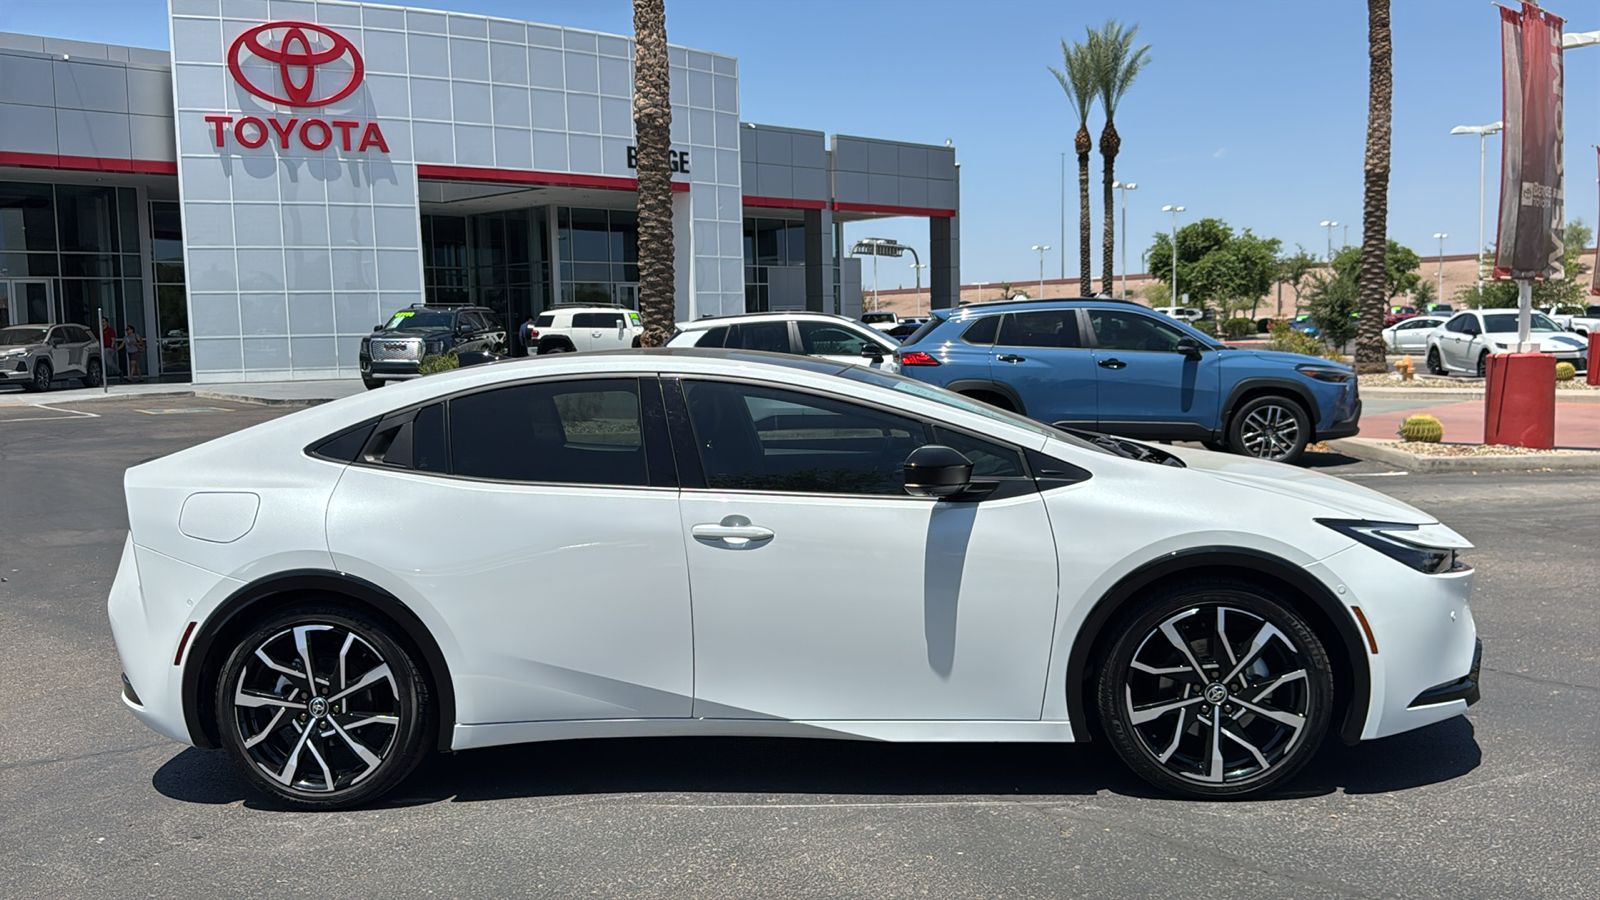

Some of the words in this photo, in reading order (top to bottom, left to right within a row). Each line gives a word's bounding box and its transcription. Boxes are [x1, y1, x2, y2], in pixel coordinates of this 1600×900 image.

[204, 115, 390, 153] TOYOTA
[627, 145, 690, 174] BGE
[1283, 614, 1325, 670] MICHELIN
